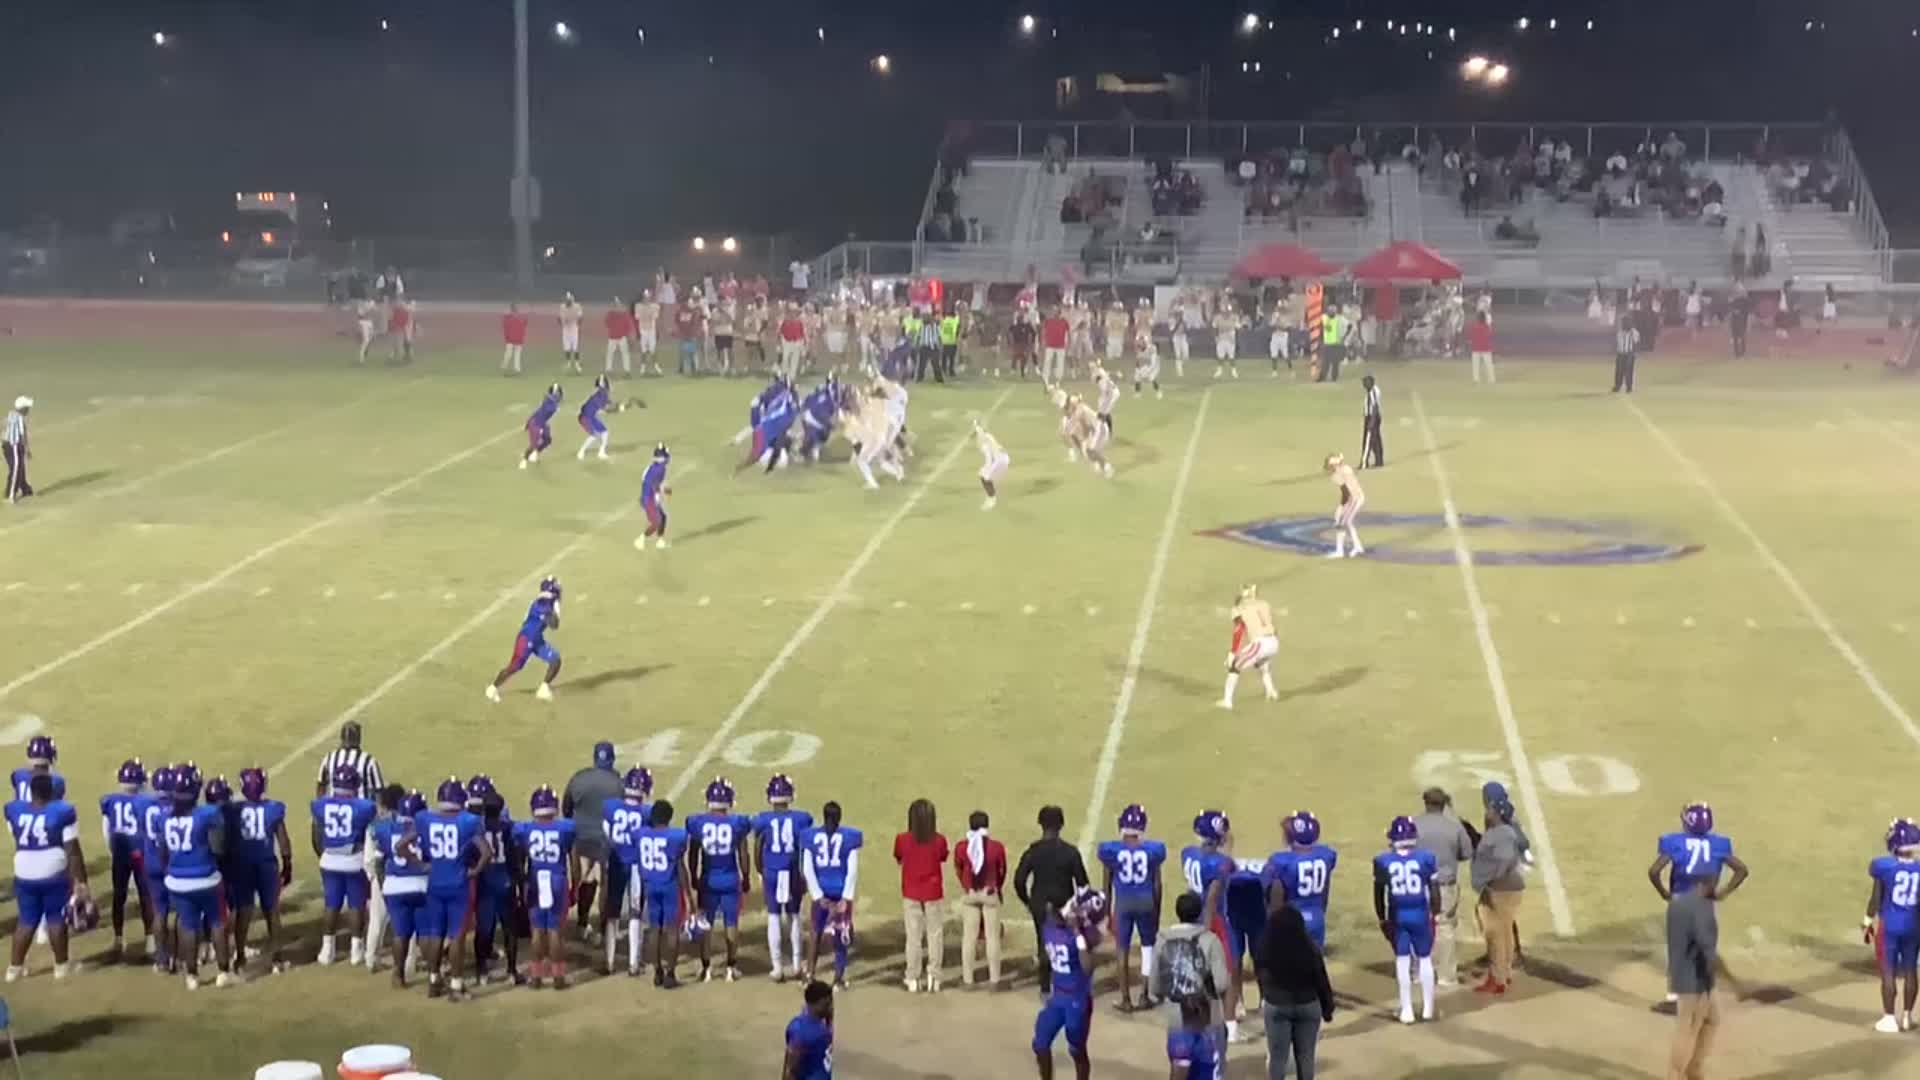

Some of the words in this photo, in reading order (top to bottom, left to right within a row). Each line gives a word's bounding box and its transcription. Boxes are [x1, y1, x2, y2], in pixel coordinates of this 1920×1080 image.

[18, 813, 48, 845] 74
[165, 816, 193, 850] 67
[241, 806, 266, 840] 31
[324, 804, 352, 837] 53
[770, 818, 794, 853] 14
[429, 822, 458, 859] 58
[529, 830, 560, 863] 25
[640, 836, 668, 872] 85
[702, 823, 732, 855] 29
[1685, 838, 1710, 873] 71
[1117, 850, 1148, 884] 33
[1297, 859, 1327, 896] 50
[1389, 860, 1421, 895] 26
[1892, 870, 1919, 905] 21
